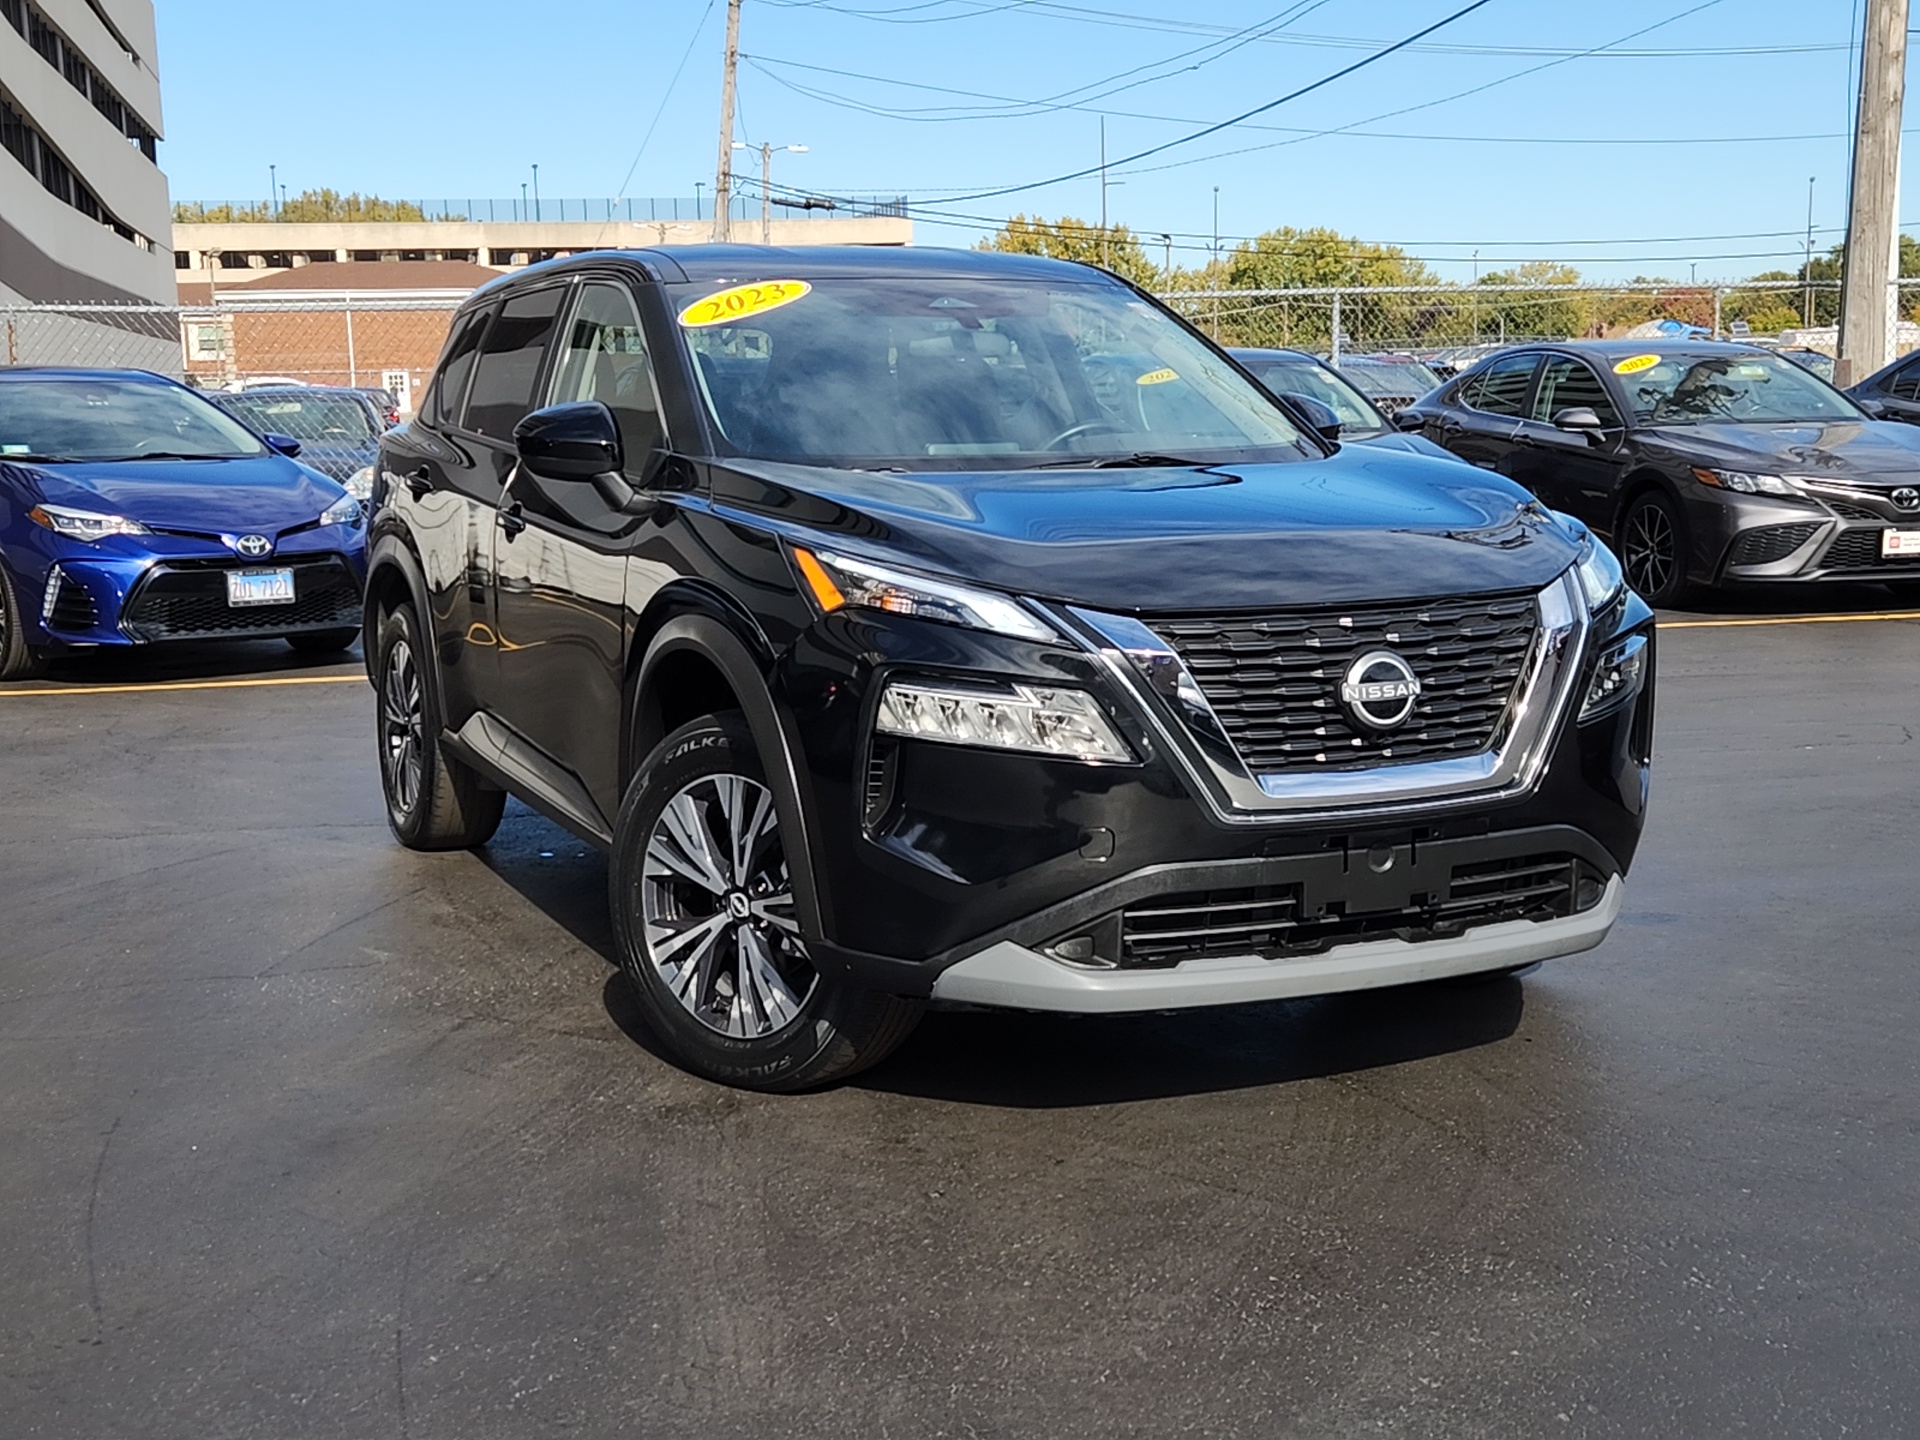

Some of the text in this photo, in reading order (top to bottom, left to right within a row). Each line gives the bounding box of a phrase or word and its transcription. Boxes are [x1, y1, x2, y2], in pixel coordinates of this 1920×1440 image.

[704, 283, 786, 321] 2023
[1620, 356, 1653, 371] 2023
[260, 579, 289, 597] 7121
[1343, 682, 1421, 700] NISSAN
[664, 735, 731, 765] FALKE
